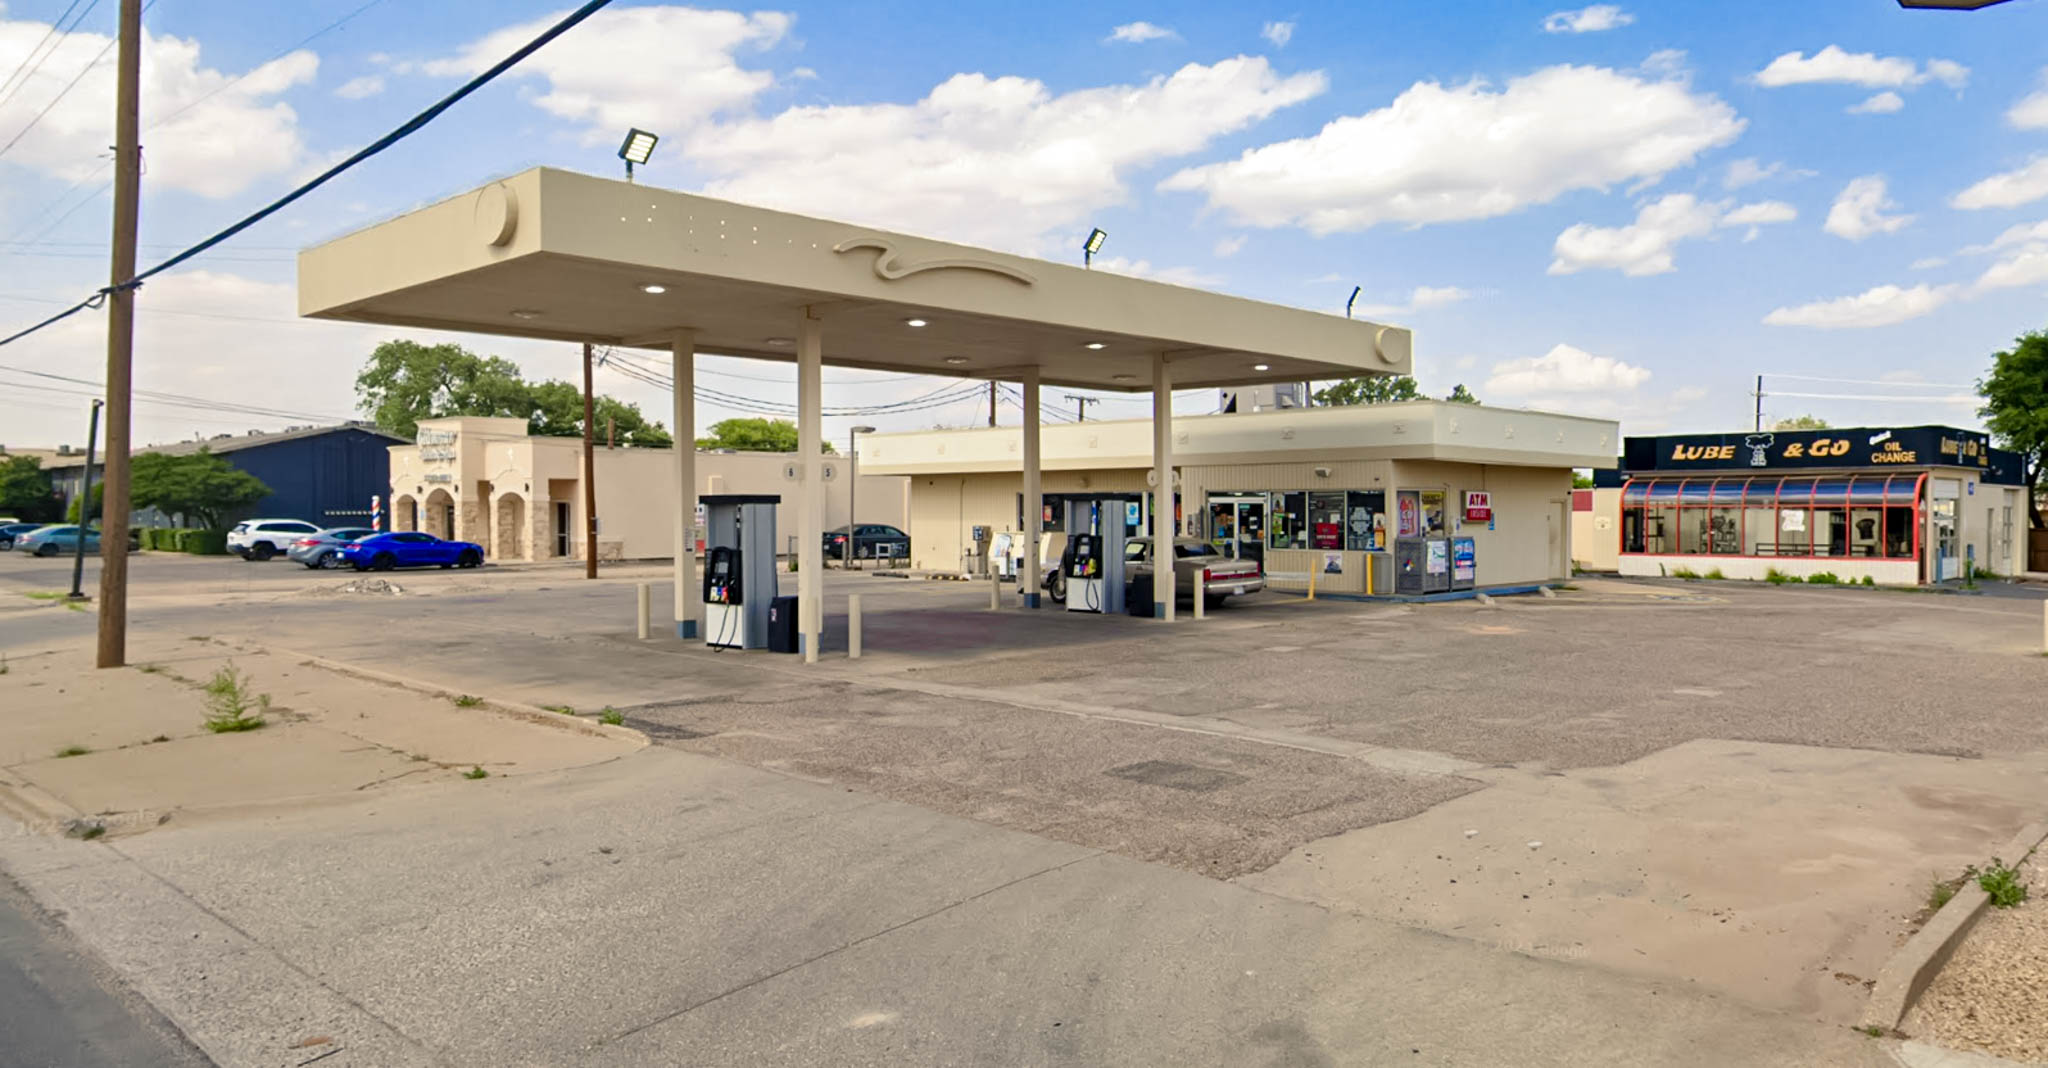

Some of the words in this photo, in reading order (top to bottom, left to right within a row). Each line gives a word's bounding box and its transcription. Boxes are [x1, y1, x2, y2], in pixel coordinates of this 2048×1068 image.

[1671, 443, 1736, 461] LUBE
[1782, 443, 1804, 458] &
[1808, 438, 1852, 457] GO
[1884, 441, 1902, 452] OIL
[1871, 451, 1917, 464] CHANGE
[1469, 493, 1489, 507] ATM
